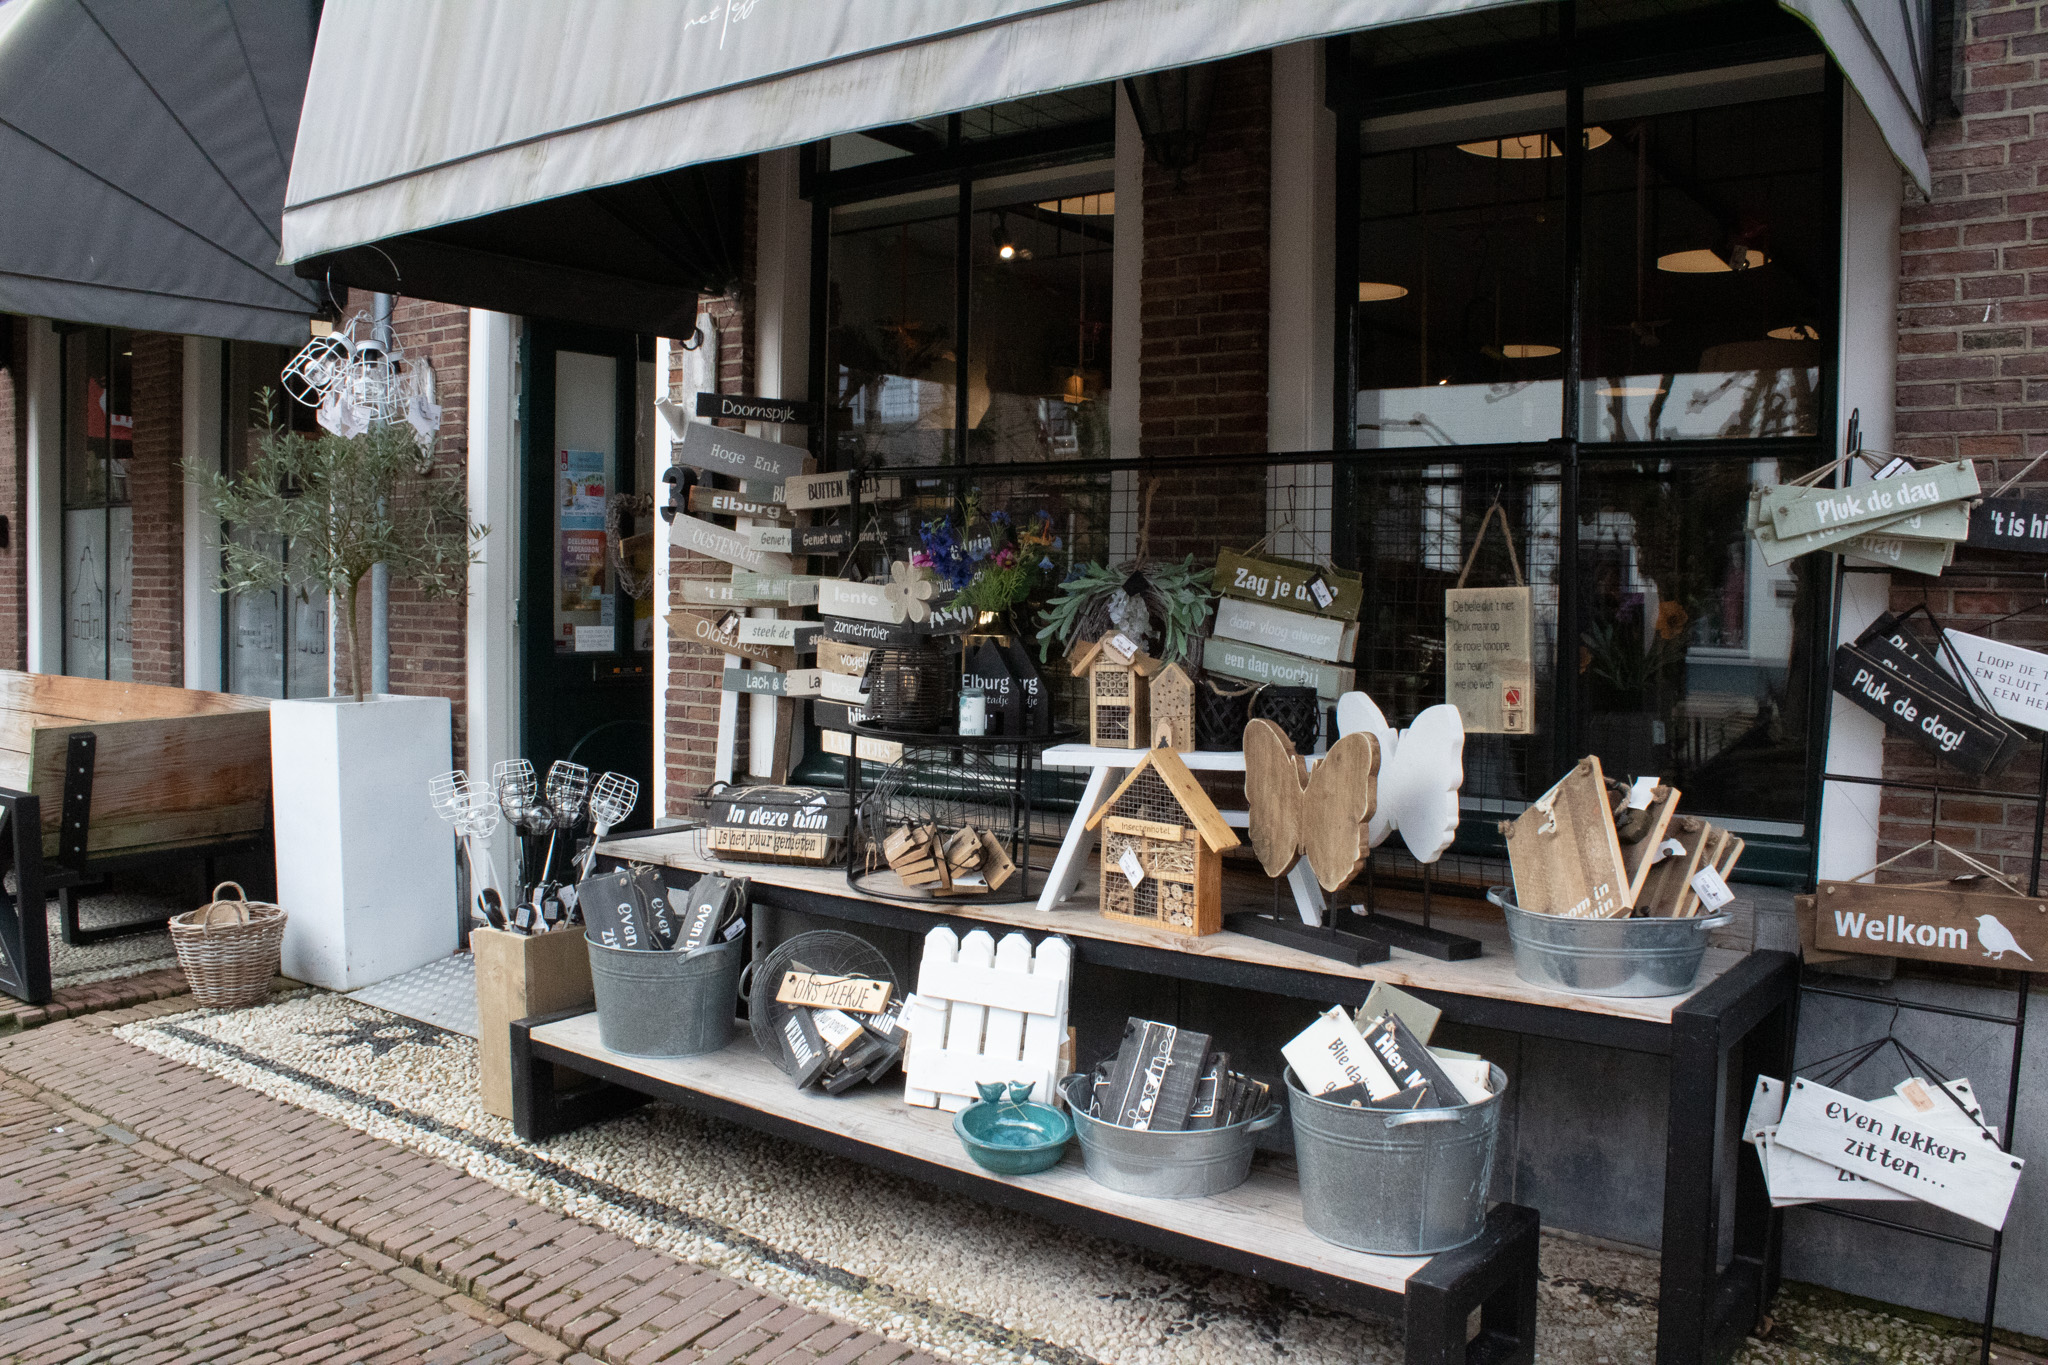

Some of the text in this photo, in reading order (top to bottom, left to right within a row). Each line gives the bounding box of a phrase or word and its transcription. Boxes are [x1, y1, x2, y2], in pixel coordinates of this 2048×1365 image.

[722, 399, 795, 422] Doornspijk
[711, 443, 780, 475] Hoge Enk
[808, 480, 843, 500] BUITEN
[1816, 481, 1940, 524] Pluk de dag
[711, 495, 781, 519] Elburg
[1991, 510, 2004, 536] 't
[2008, 511, 2025, 537] is
[692, 528, 764, 565] OOSTENDORP
[802, 532, 828, 546] Geniet
[829, 534, 843, 545] van
[834, 586, 879, 607] lente
[1234, 567, 1269, 598] Zag
[1271, 575, 1290, 599] je
[752, 624, 790, 639] steek de
[1230, 613, 1331, 646] daar vloog alweer
[1225, 652, 1319, 689] een dag voorbij
[1977, 651, 2014, 670] LOOP
[2019, 664, 2036, 677] DE
[746, 673, 780, 691] Lach &
[961, 673, 1010, 694] Elburg
[1975, 667, 2041, 693] EN SLUIT
[1993, 686, 2021, 703] EEN
[1852, 668, 1892, 705] Pluk
[1893, 697, 1919, 723] de
[1921, 714, 1966, 751] dag!
[726, 804, 829, 830] In deze tuin
[1121, 821, 1171, 835] Insectenhotel
[729, 831, 746, 846] het
[748, 833, 773, 850] puur
[773, 833, 816, 852] genieten
[1593, 882, 1610, 900] in
[617, 902, 639, 947] even
[689, 903, 713, 938] even
[1834, 910, 1968, 950] Welkom
[793, 979, 870, 1009] ONS PLEKJE
[783, 1014, 813, 1070] WELKOM
[1327, 1036, 1350, 1066] Blie
[1374, 1031, 1410, 1073] Hier
[1825, 1101, 1967, 1165] even lekker
[1844, 1137, 1946, 1189] zitten...
